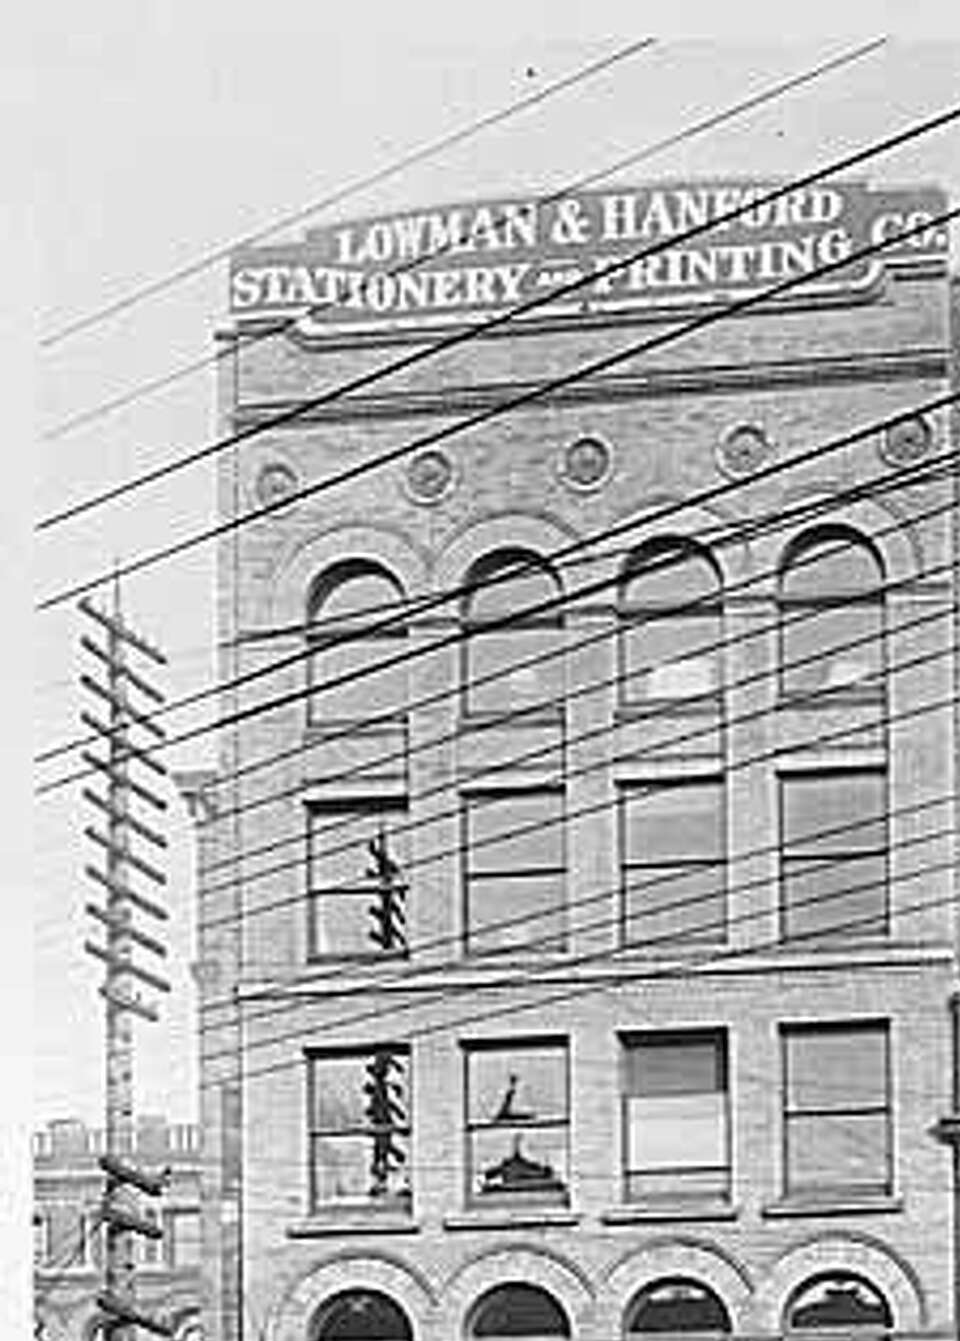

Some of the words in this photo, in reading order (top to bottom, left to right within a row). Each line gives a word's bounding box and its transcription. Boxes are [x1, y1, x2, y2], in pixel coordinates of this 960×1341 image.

[233, 264, 530, 311] STATIONERY
[596, 229, 853, 292] PRINTING
[872, 211, 948, 249] CO.
[337, 203, 538, 264] LOWMAN
[552, 199, 591, 244] &
[603, 187, 845, 239] HANFORD
